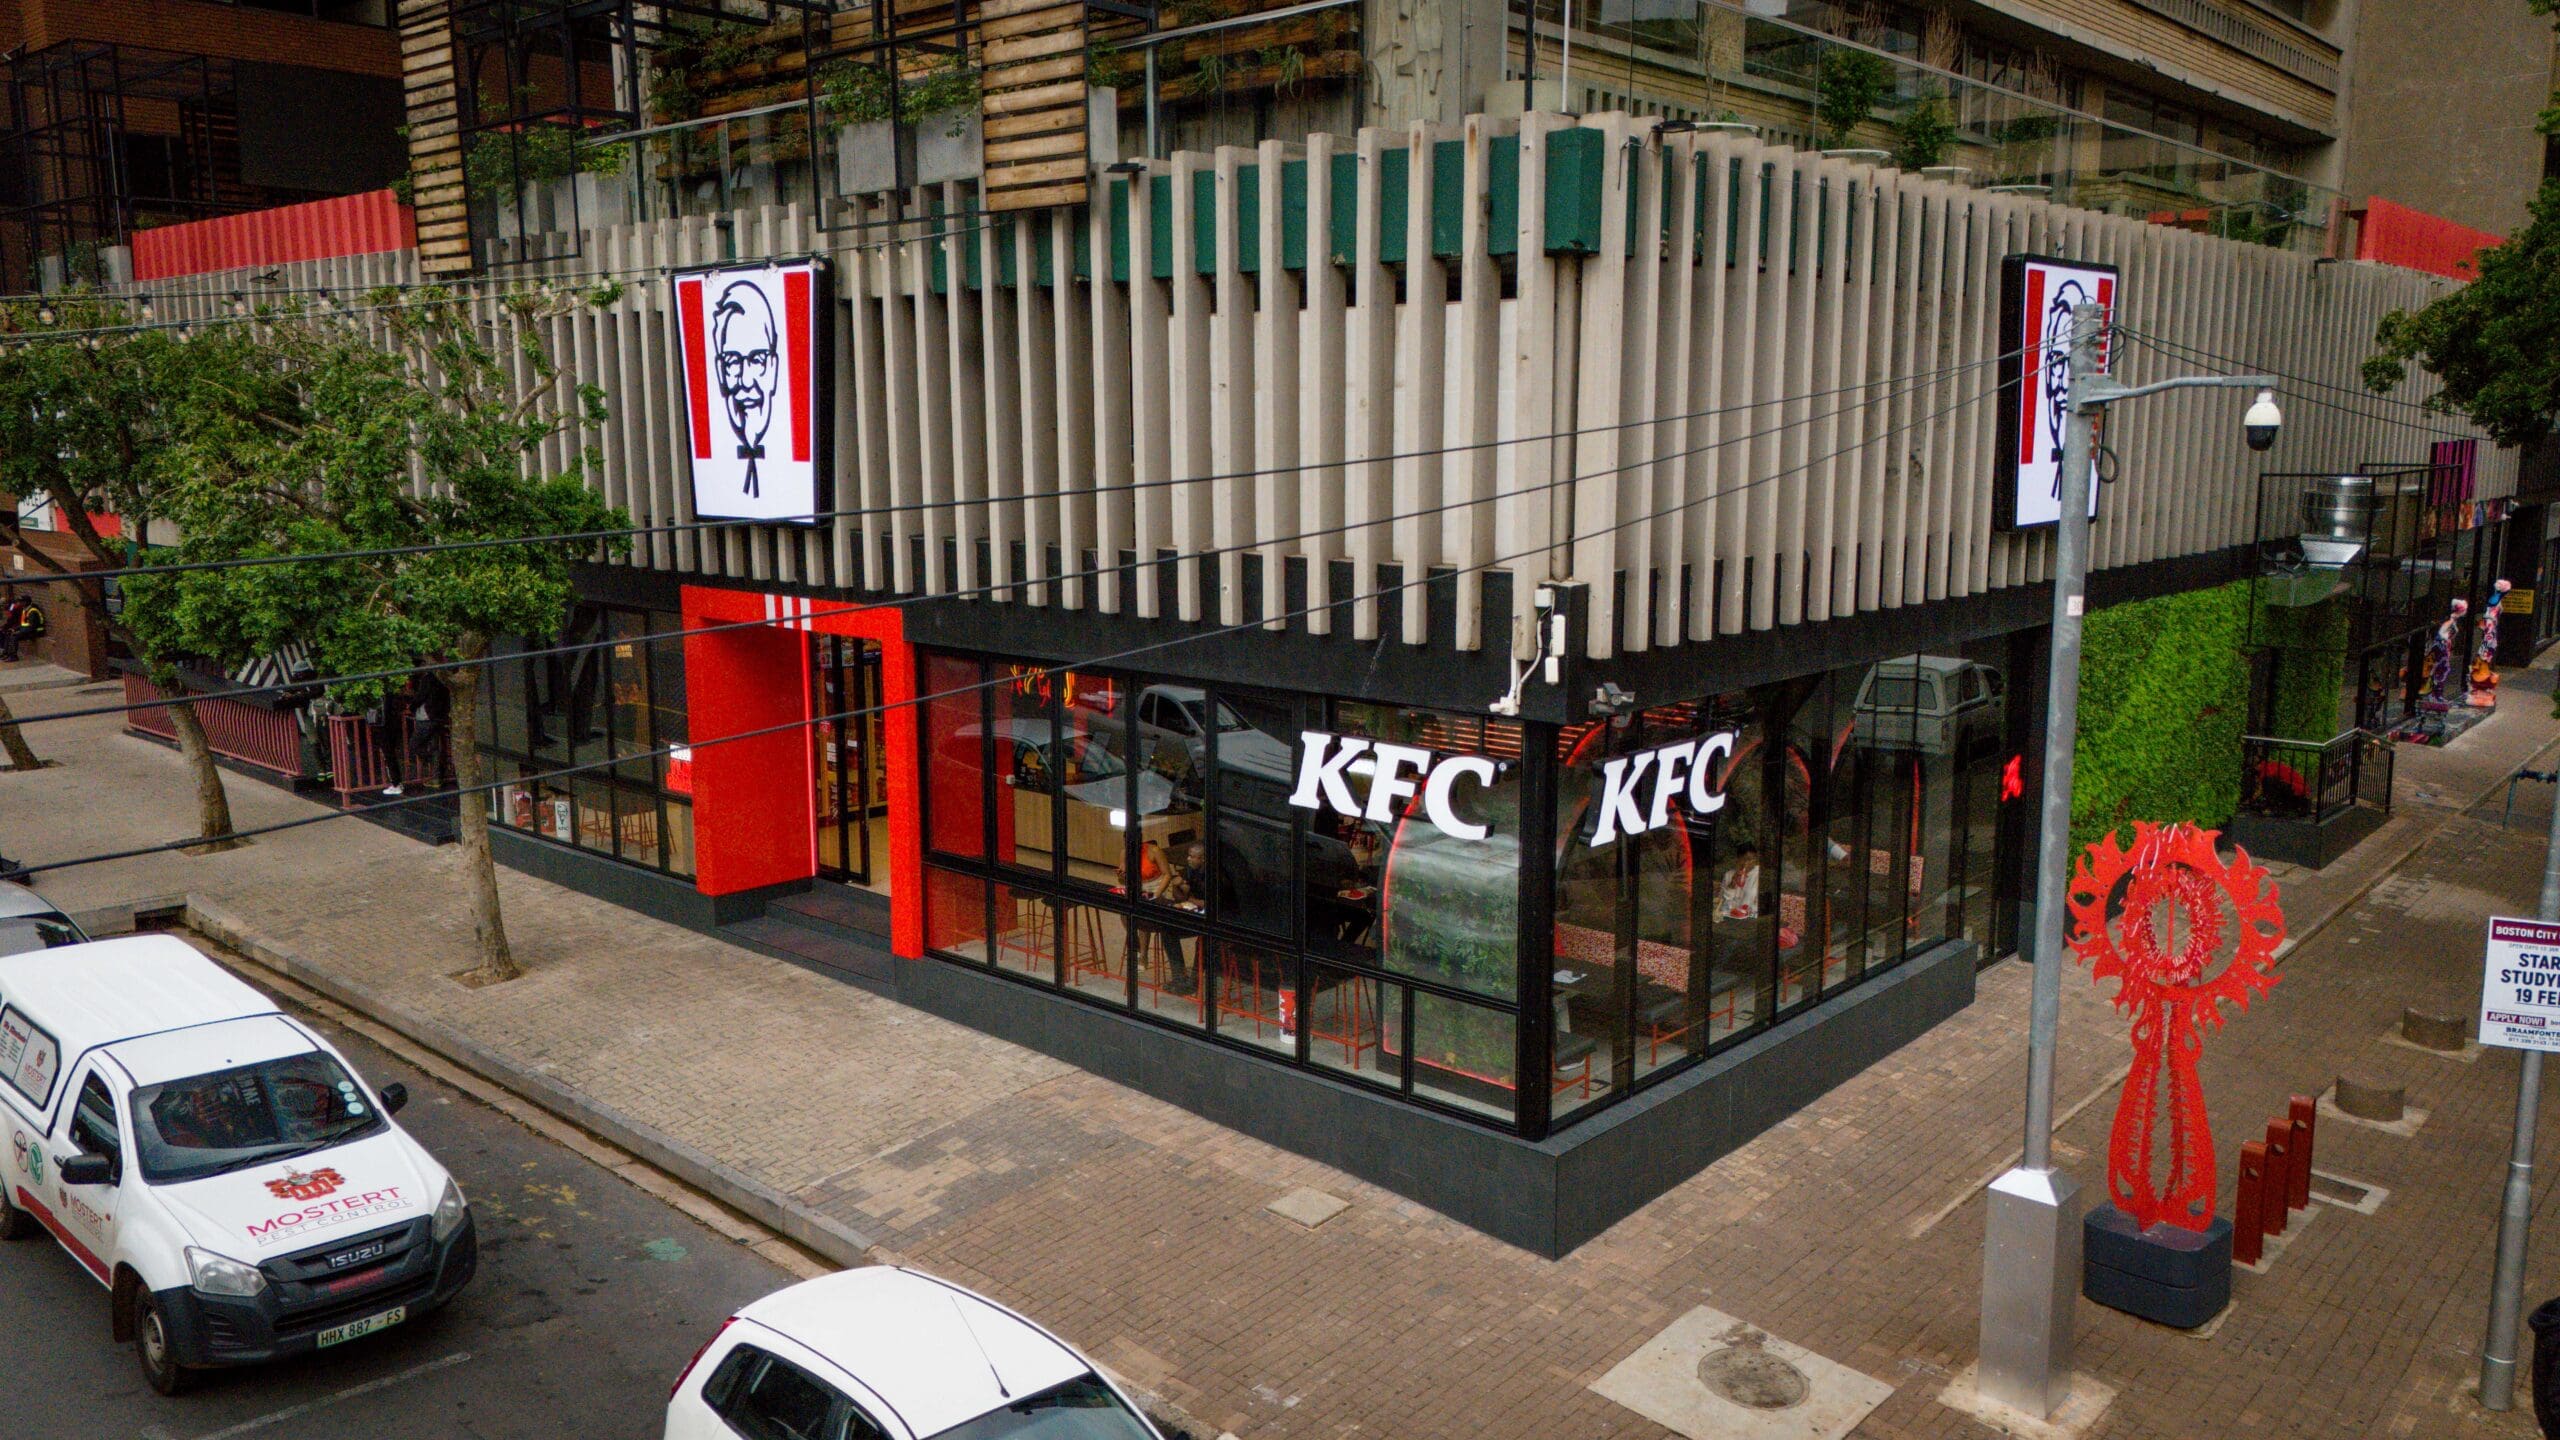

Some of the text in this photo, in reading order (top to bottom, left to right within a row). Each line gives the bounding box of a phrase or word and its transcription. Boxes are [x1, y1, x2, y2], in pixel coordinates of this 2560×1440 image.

[1288, 730, 1495, 840] KFC
[1590, 731, 1733, 847] KFC
[2495, 926, 2557, 940] BOSTON CITY
[2515, 988, 2560, 1006] 19 FE
[2489, 1012, 2518, 1024] APPLY
[2518, 1015, 2544, 1026] NOW!
[246, 1187, 401, 1237] MOSTERT
[256, 1199, 414, 1245] PEST CONTROL
[331, 1244, 383, 1268] ISUZU
[320, 1308, 401, 1346] HHX 887 FS
